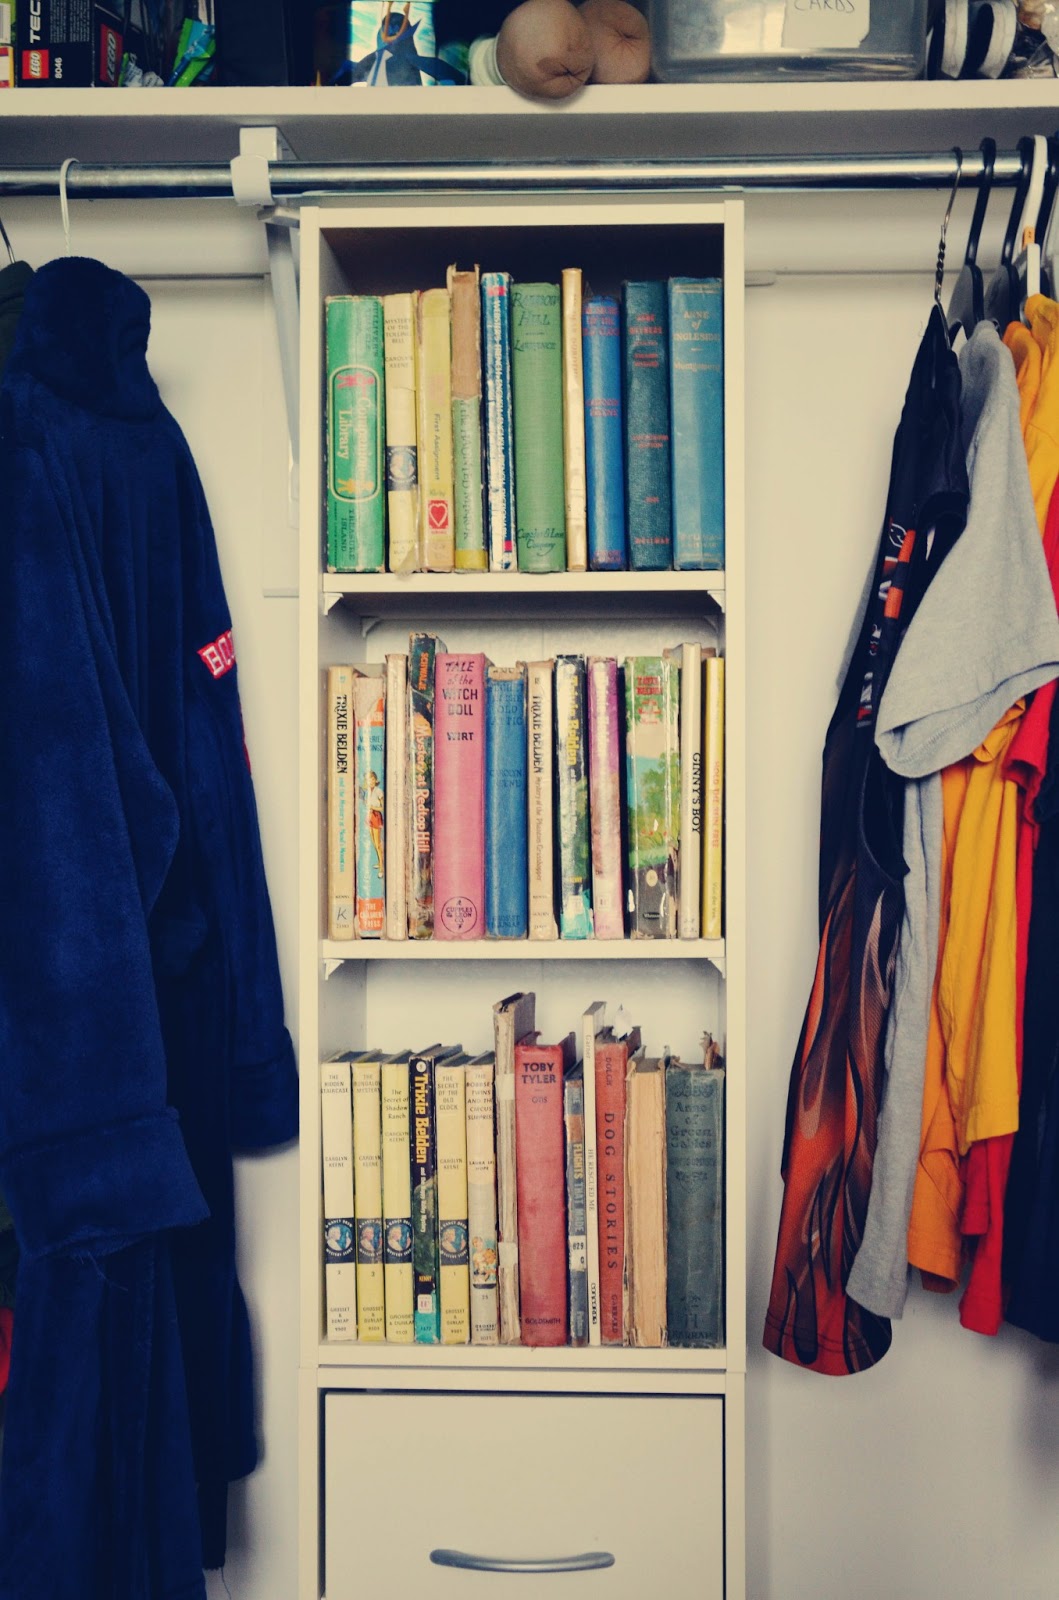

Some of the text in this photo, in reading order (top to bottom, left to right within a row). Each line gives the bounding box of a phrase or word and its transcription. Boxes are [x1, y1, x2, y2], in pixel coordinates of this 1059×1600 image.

[30, 51, 42, 77] LEGO
[54, 57, 63, 79] 8046
[107, 31, 117, 82] LEGO
[683, 310, 709, 320] ANNE
[337, 409, 352, 460] Library
[432, 434, 441, 481] Assignment
[341, 517, 349, 552] ISLAND
[446, 661, 475, 672] TALE
[460, 674, 474, 685] the
[442, 688, 478, 700] WITCH
[448, 704, 474, 715] DOLL
[335, 694, 348, 731] TRIXIE
[531, 694, 544, 731] TRIXIE
[336, 733, 348, 774] BELDEN
[532, 732, 545, 775] BELDEN
[566, 718, 580, 766] Belden
[415, 725, 431, 853] Mystery at Redtop Hill
[691, 751, 701, 834] GINNY'S BOY
[712, 829, 720, 849] FREE
[585, 1034, 593, 1059] Garner
[521, 1074, 557, 1084] TYLER
[523, 1062, 554, 1073] TOBY
[605, 1057, 613, 1087] DOLCH
[414, 1073, 429, 1115] Trixie
[415, 1116, 431, 1163] Belden
[670, 1125, 711, 1137] Green
[573, 1143, 585, 1233] FLIGHTS THAT MADE
[586, 1160, 595, 1197] RESCUED
[603, 1112, 619, 1270] DOG STORIES
[588, 1198, 596, 1212] ME
[524, 1317, 561, 1326] GOLDSMITH
